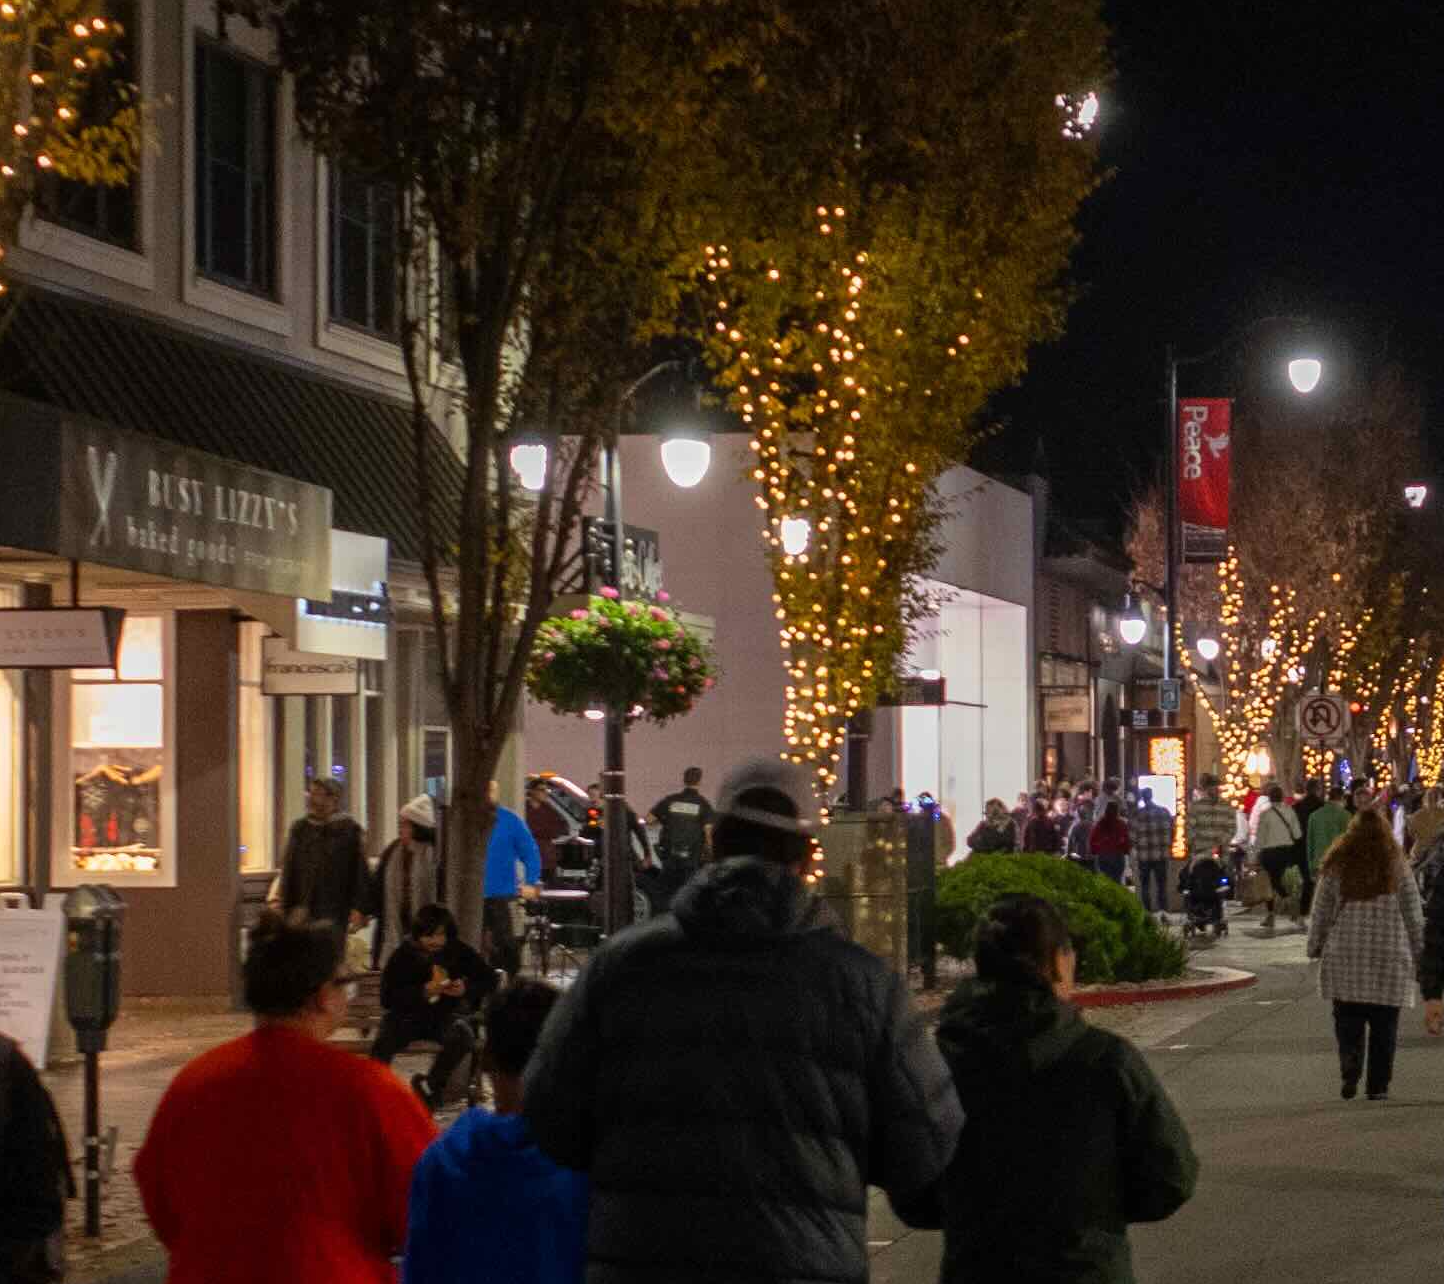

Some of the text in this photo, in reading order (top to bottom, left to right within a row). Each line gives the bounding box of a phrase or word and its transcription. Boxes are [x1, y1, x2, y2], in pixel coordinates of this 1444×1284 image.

[1182, 405, 1209, 481] Peace
[148, 469, 205, 516] BUSY
[127, 516, 179, 555] baked
[186, 534, 237, 566] goods
